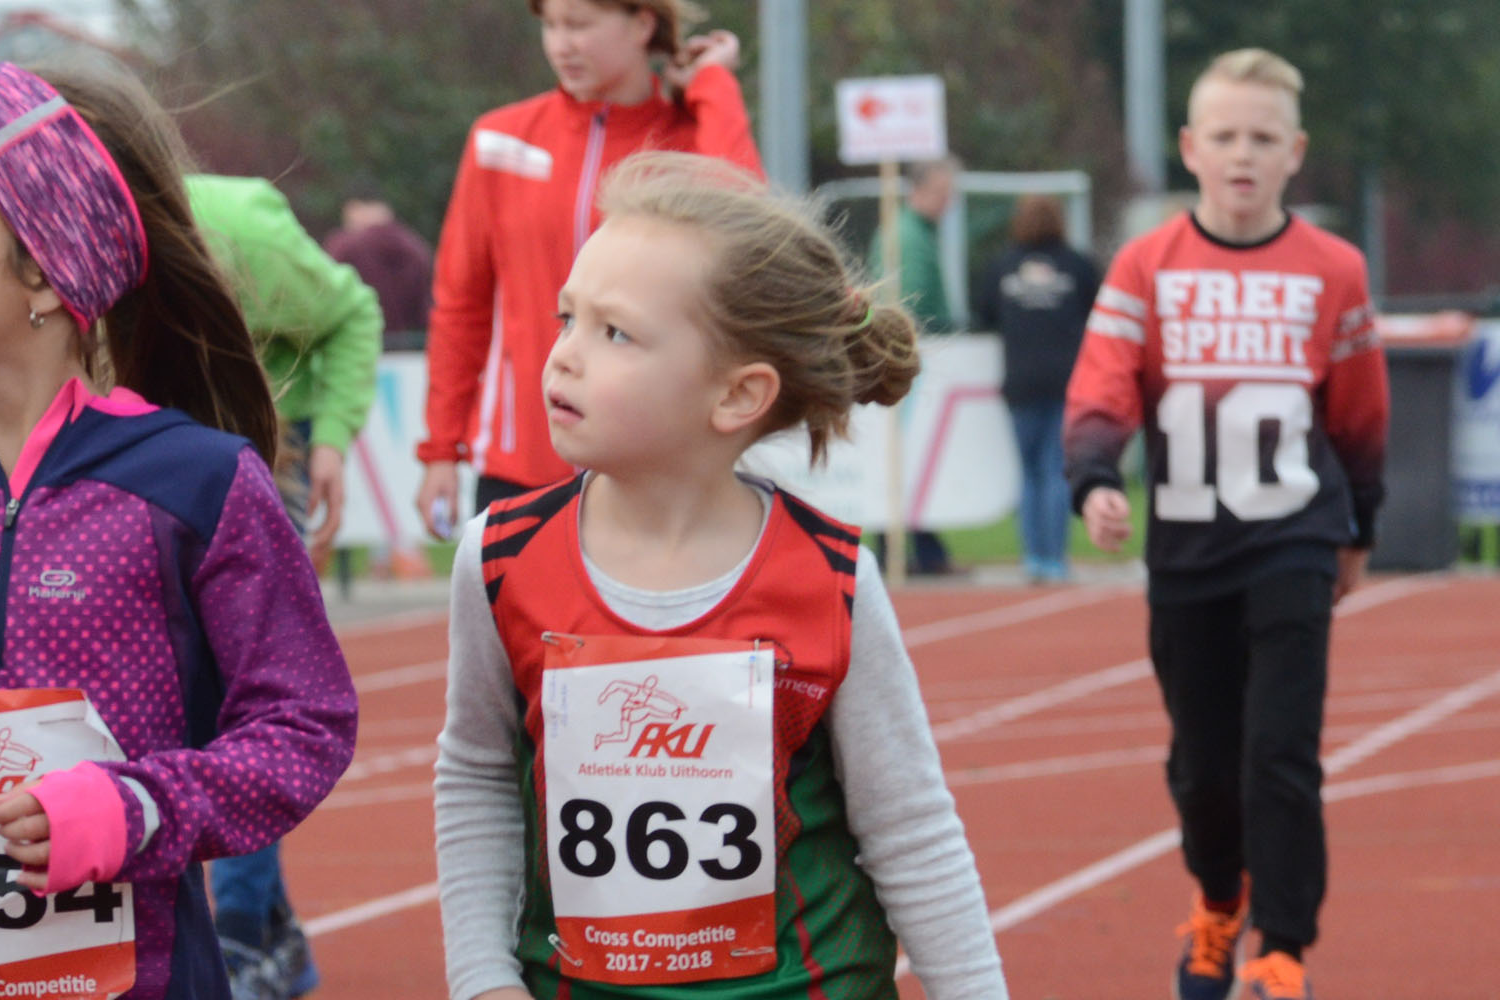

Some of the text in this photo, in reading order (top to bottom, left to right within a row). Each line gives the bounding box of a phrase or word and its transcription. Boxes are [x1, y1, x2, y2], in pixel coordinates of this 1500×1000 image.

[1154, 269, 1324, 322] FREE
[1160, 319, 1312, 365] SPIRIT
[1155, 381, 1320, 522] 10
[28, 586, 86, 602] Kalenji
[626, 722, 717, 760] AKU
[578, 763, 733, 779] Atletiek Klub Uithoorn
[558, 798, 762, 881] 863
[584, 924, 736, 949] Cross Competitie
[605, 953, 650, 972] 2017
[666, 951, 713, 971] 2018
